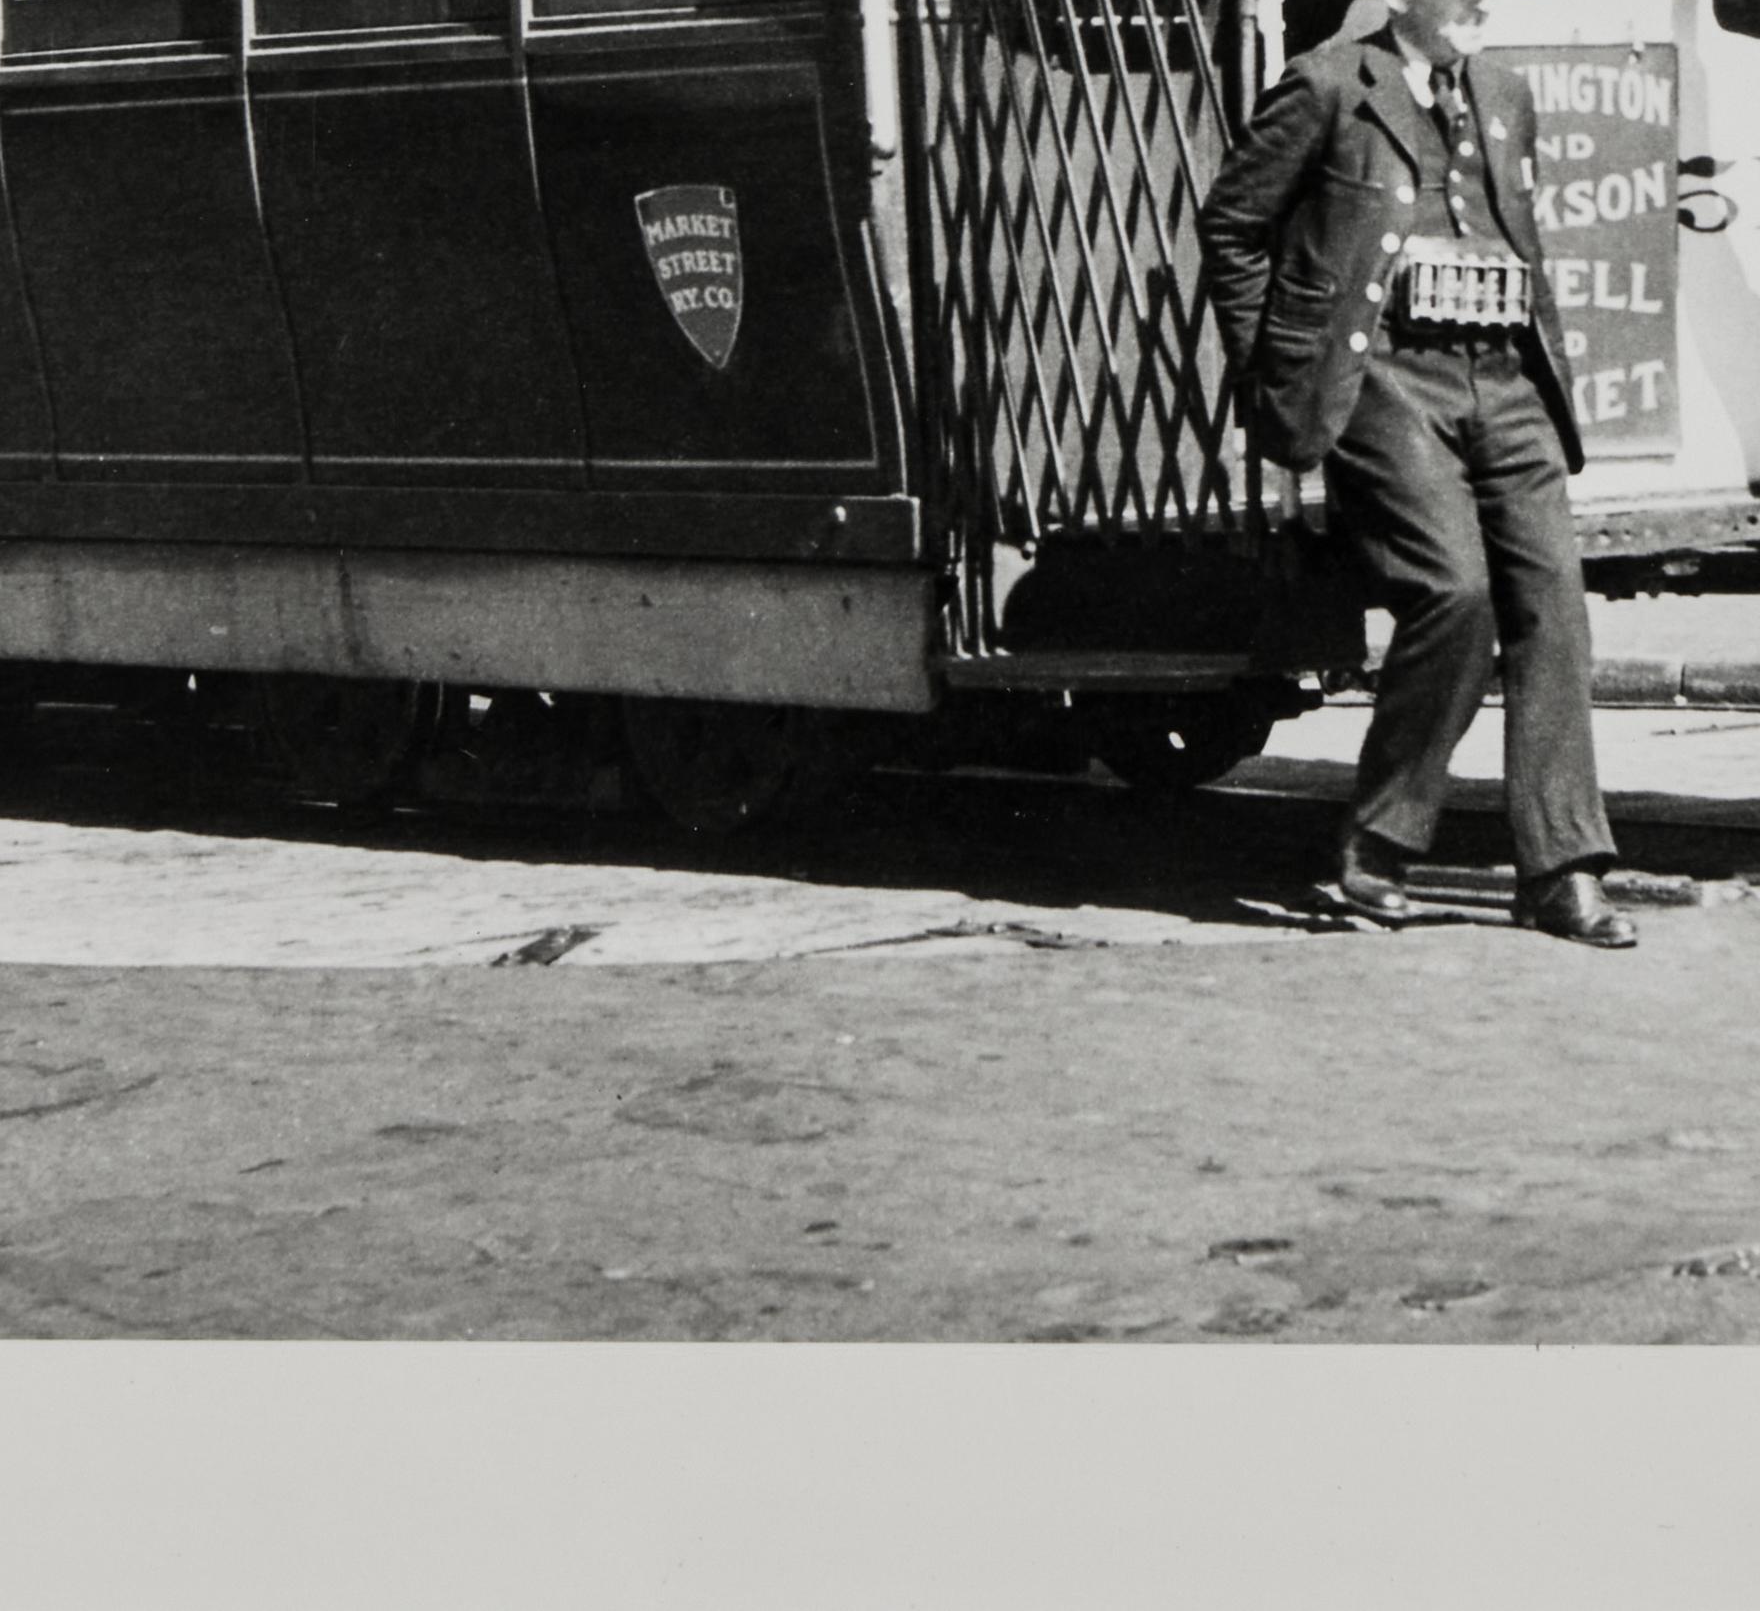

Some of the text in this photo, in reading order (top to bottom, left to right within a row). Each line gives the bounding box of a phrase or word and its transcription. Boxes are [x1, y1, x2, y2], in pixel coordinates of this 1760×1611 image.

[1524, 62, 1672, 128] INGTON
[1536, 132, 1596, 161] ND
[1533, 160, 1667, 231] KSON
[645, 214, 734, 246] MARKET
[657, 249, 736, 280] STREET
[1545, 257, 1664, 314] ELL
[1571, 358, 1667, 426] KET
